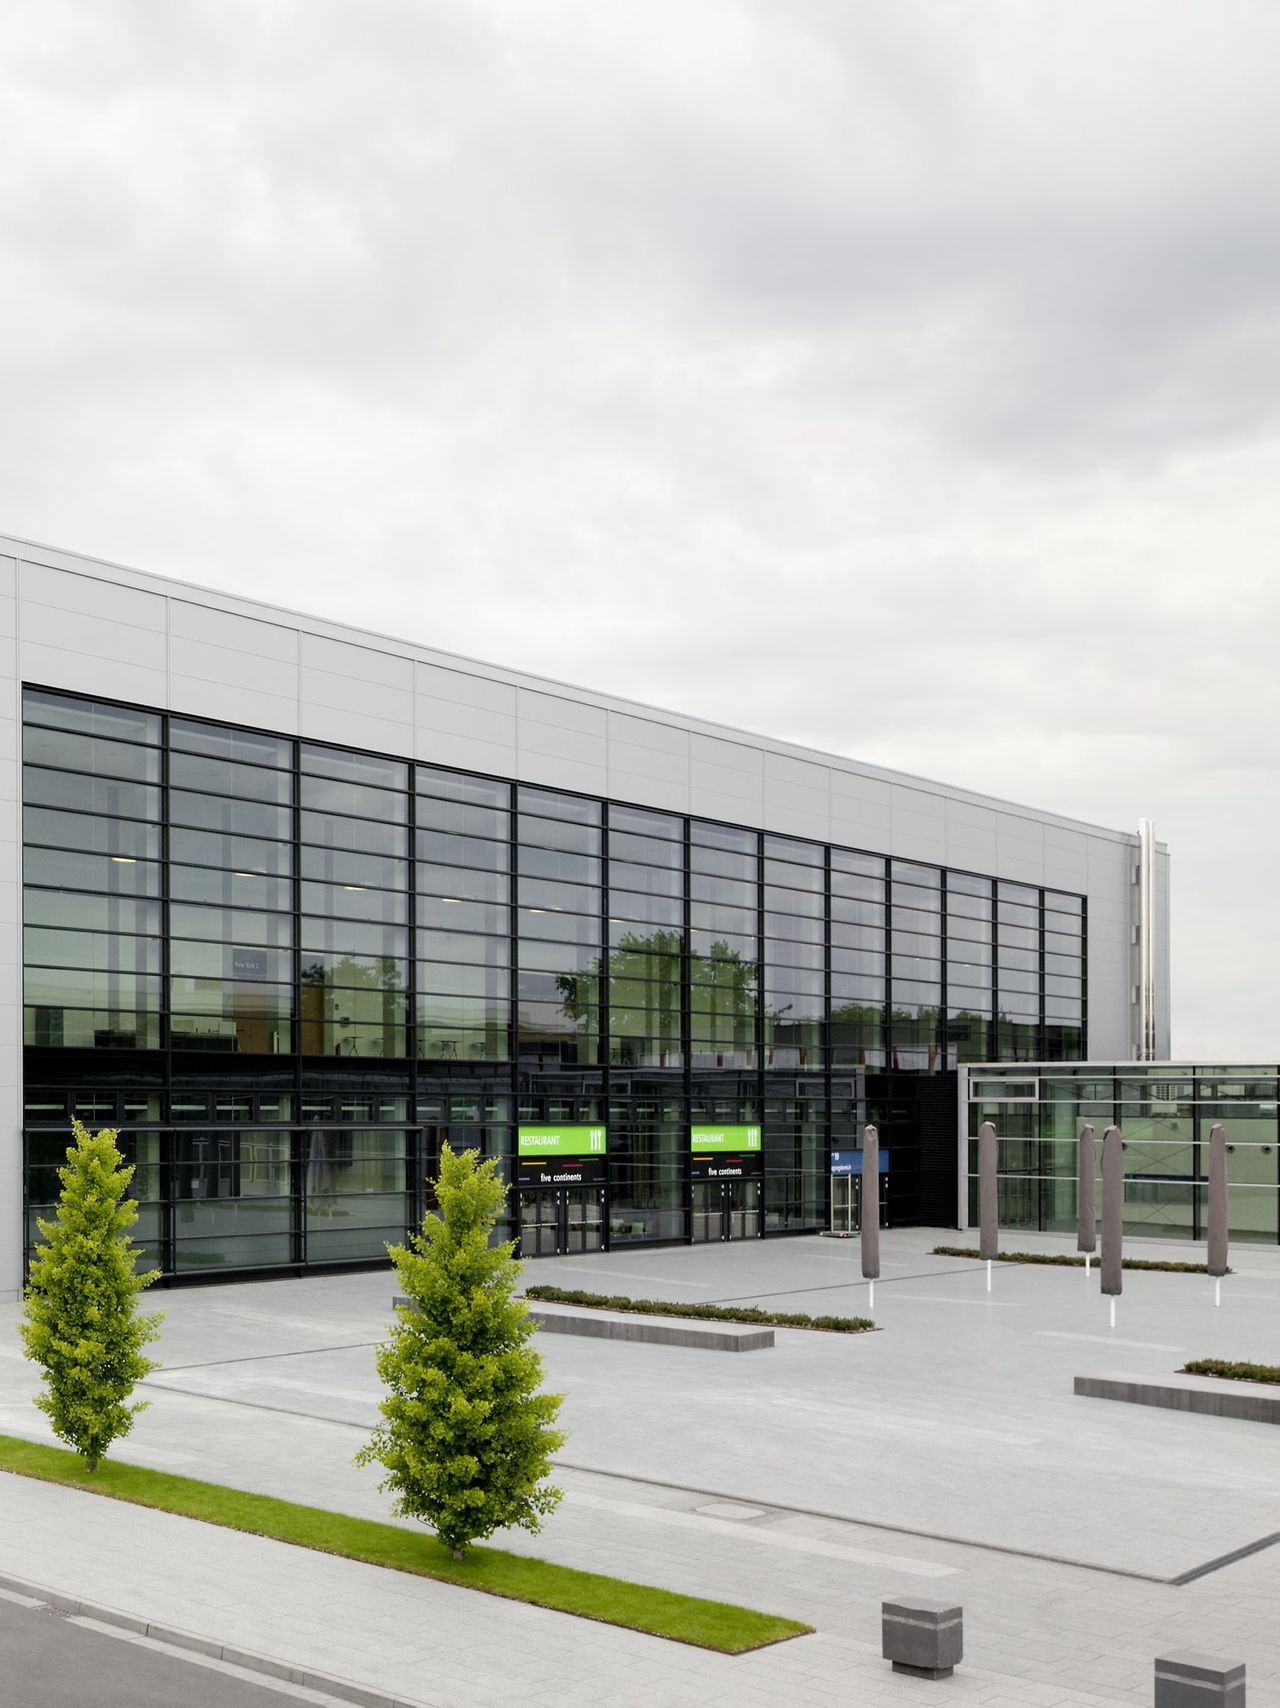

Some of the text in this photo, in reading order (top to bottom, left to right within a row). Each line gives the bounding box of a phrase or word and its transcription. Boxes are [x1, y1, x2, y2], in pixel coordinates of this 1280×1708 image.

[520, 1135, 560, 1146] RESTAURANT
[692, 1133, 724, 1143] RESTAURANT
[708, 1167, 742, 1176] five continents
[540, 1173, 582, 1182] five continents
